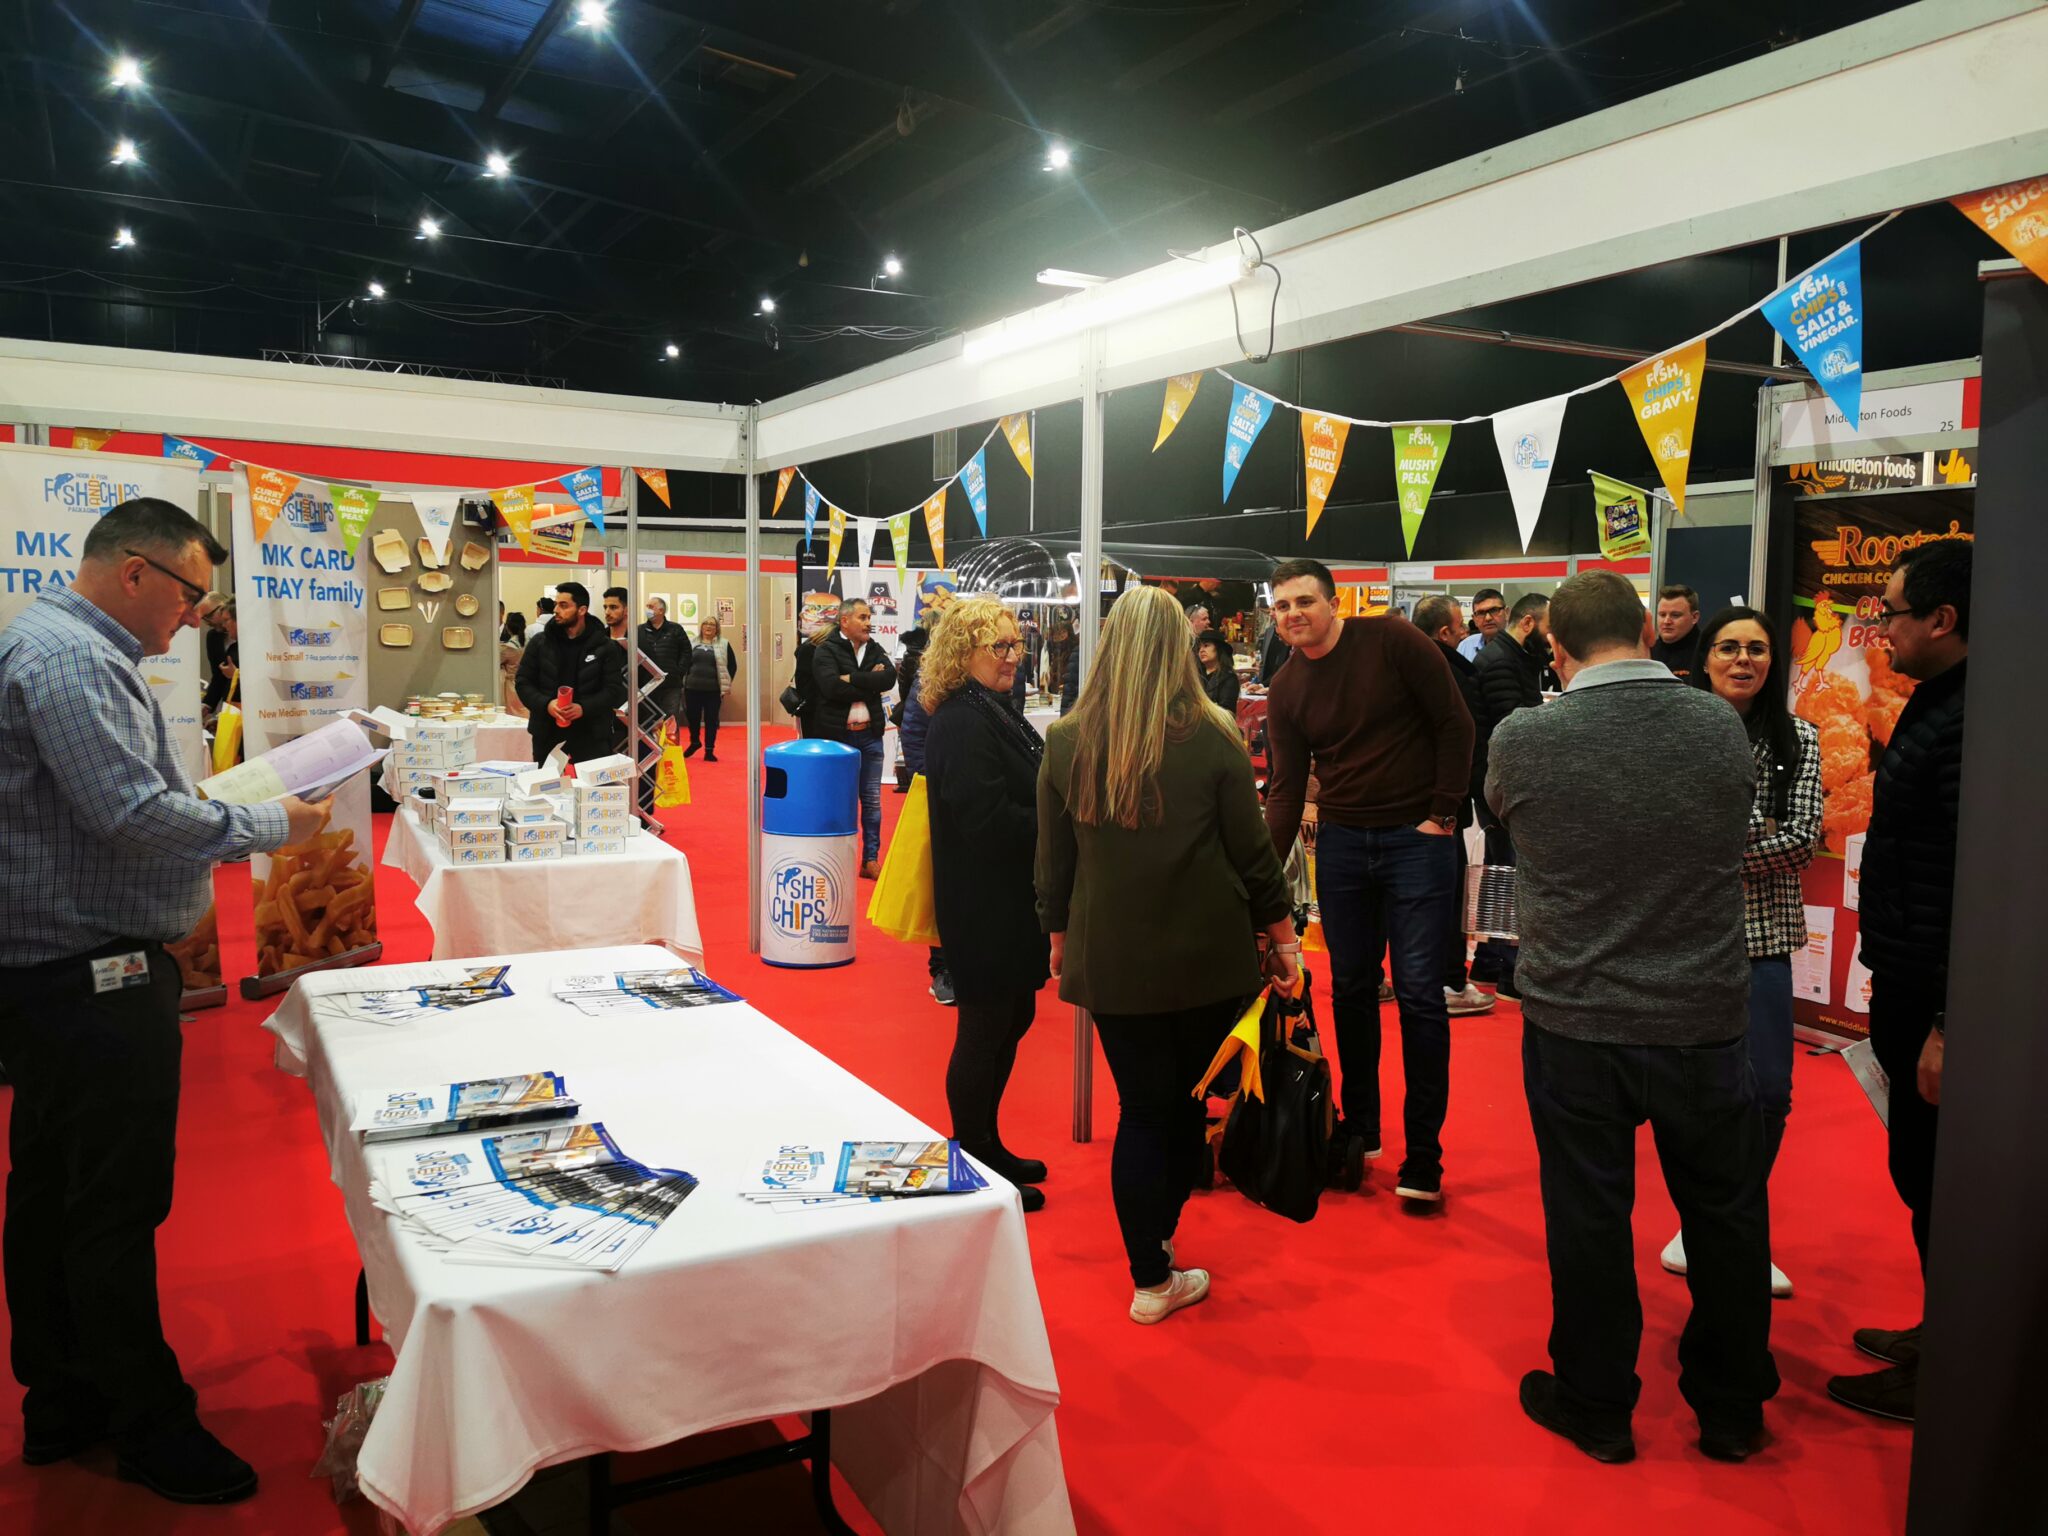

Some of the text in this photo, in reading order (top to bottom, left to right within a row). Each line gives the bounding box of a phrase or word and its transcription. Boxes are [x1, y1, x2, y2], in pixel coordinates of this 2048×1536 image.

[1791, 288, 1838, 325] CHIPS
[1797, 300, 1852, 341] SALT &
[1800, 315, 1858, 353] VINEGAR.
[1643, 377, 1683, 403] CHIPS
[1641, 388, 1695, 419] GRAVY.
[1824, 405, 1912, 425] Midton Foods
[1940, 420, 1954, 432] 25
[1310, 445, 1337, 461] CURRY
[1399, 459, 1437, 471] MUSHY
[1402, 472, 1430, 484] PEAS.
[1883, 455, 1916, 479] foods
[88, 480, 100, 506] AND
[100, 481, 140, 507] CHIPS
[16, 531, 73, 558] MK
[261, 543, 355, 571] MK CARD
[1822, 572, 1873, 585] CHICKEN
[252, 575, 363, 609] TRAY family
[161, 656, 181, 664] chips
[266, 652, 282, 662] New
[283, 652, 304, 661] Small
[259, 709, 276, 719] New
[278, 707, 307, 718] Medium
[776, 867, 826, 900] FISH AND
[772, 896, 826, 930] CHIPS
